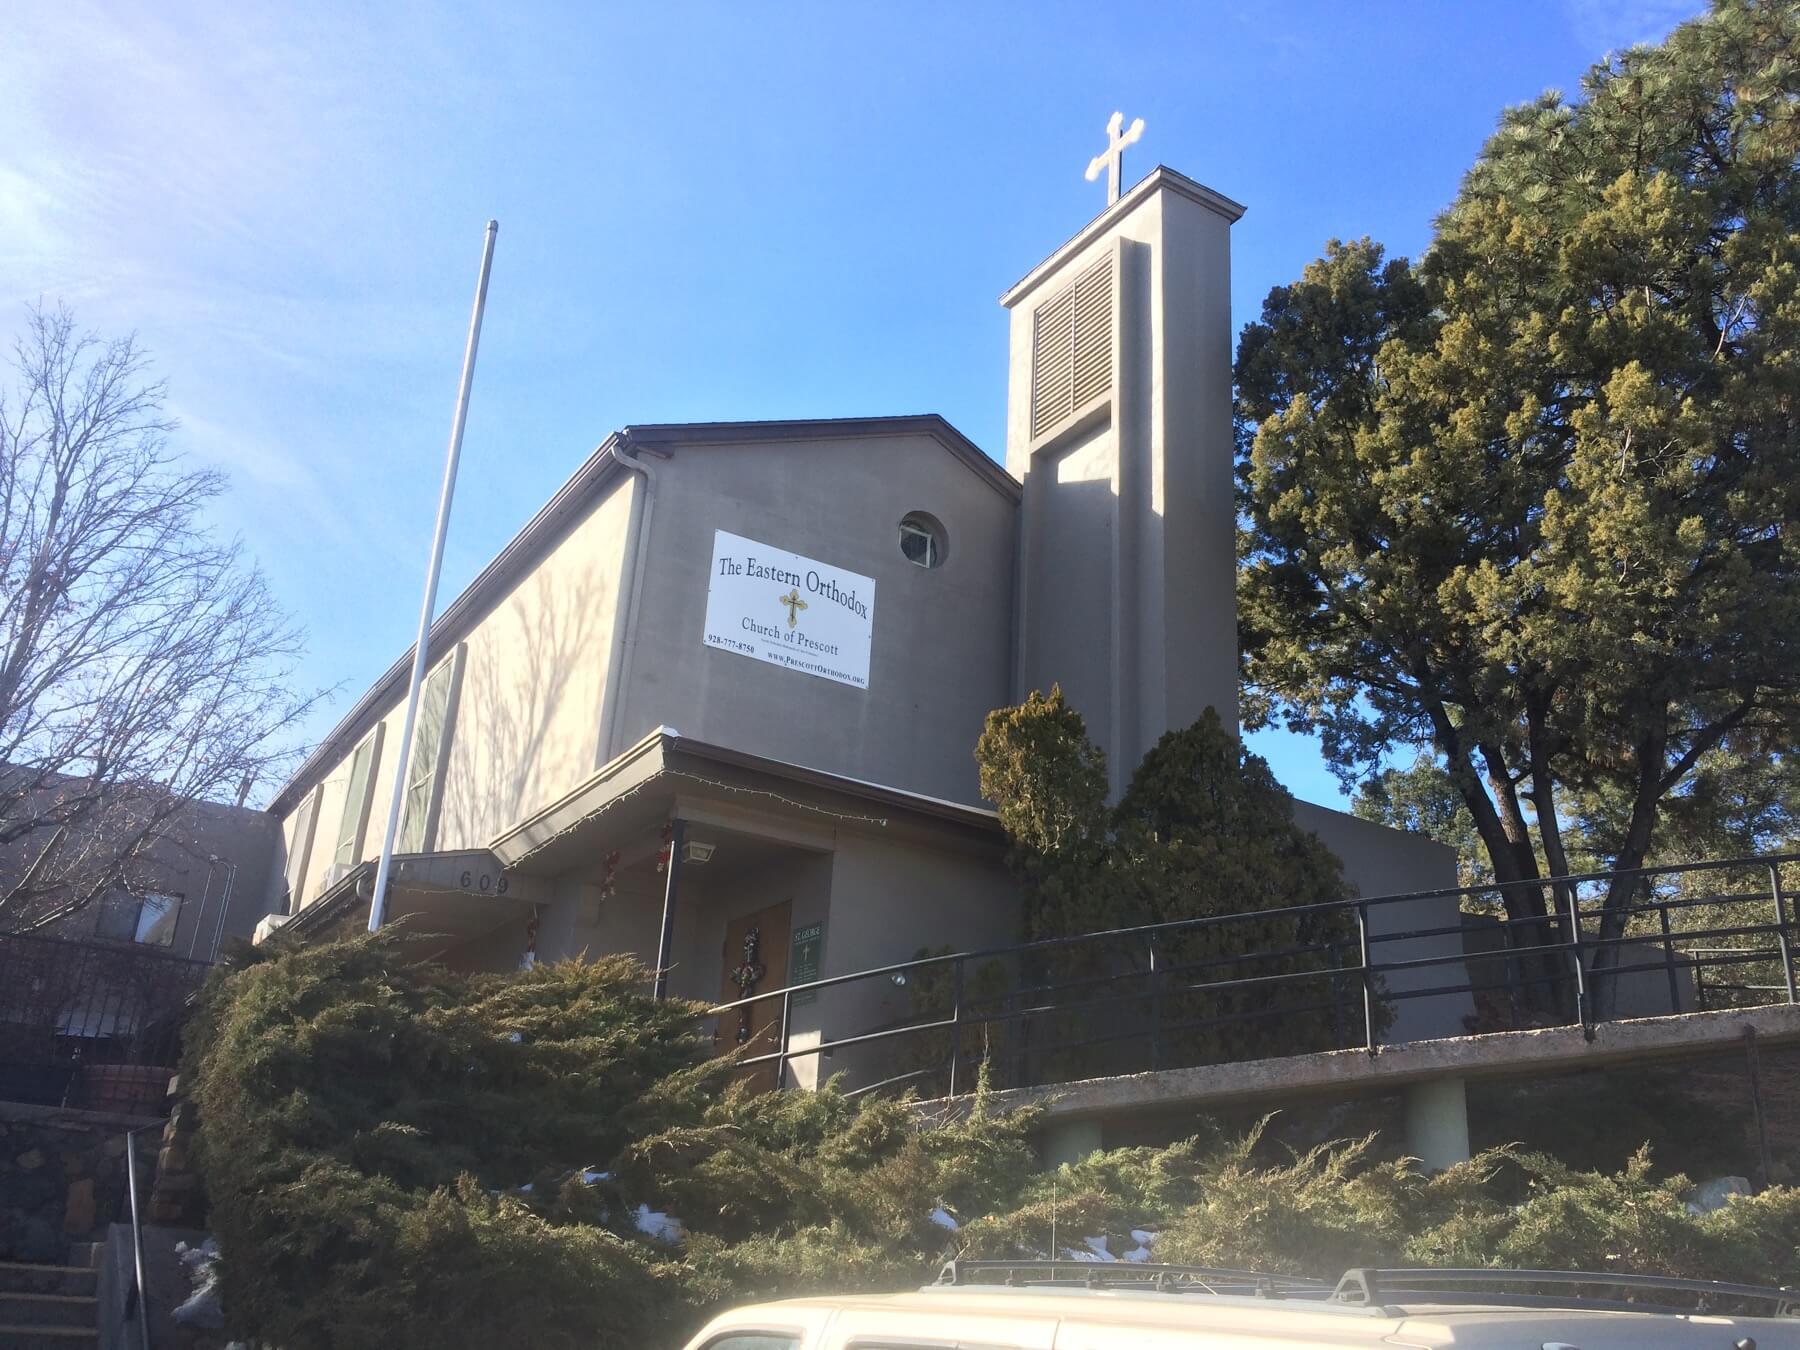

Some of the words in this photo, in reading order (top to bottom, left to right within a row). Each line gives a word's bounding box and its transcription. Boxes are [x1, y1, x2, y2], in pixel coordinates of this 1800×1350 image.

[719, 557, 742, 576] The
[746, 557, 801, 588] Eastern
[806, 570, 868, 620] Orthodox
[708, 634, 755, 654] 928-777-8750
[741, 616, 780, 639] Church
[784, 630, 796, 643] of
[798, 632, 839, 656] Prescott
[461, 871, 508, 894] 609
